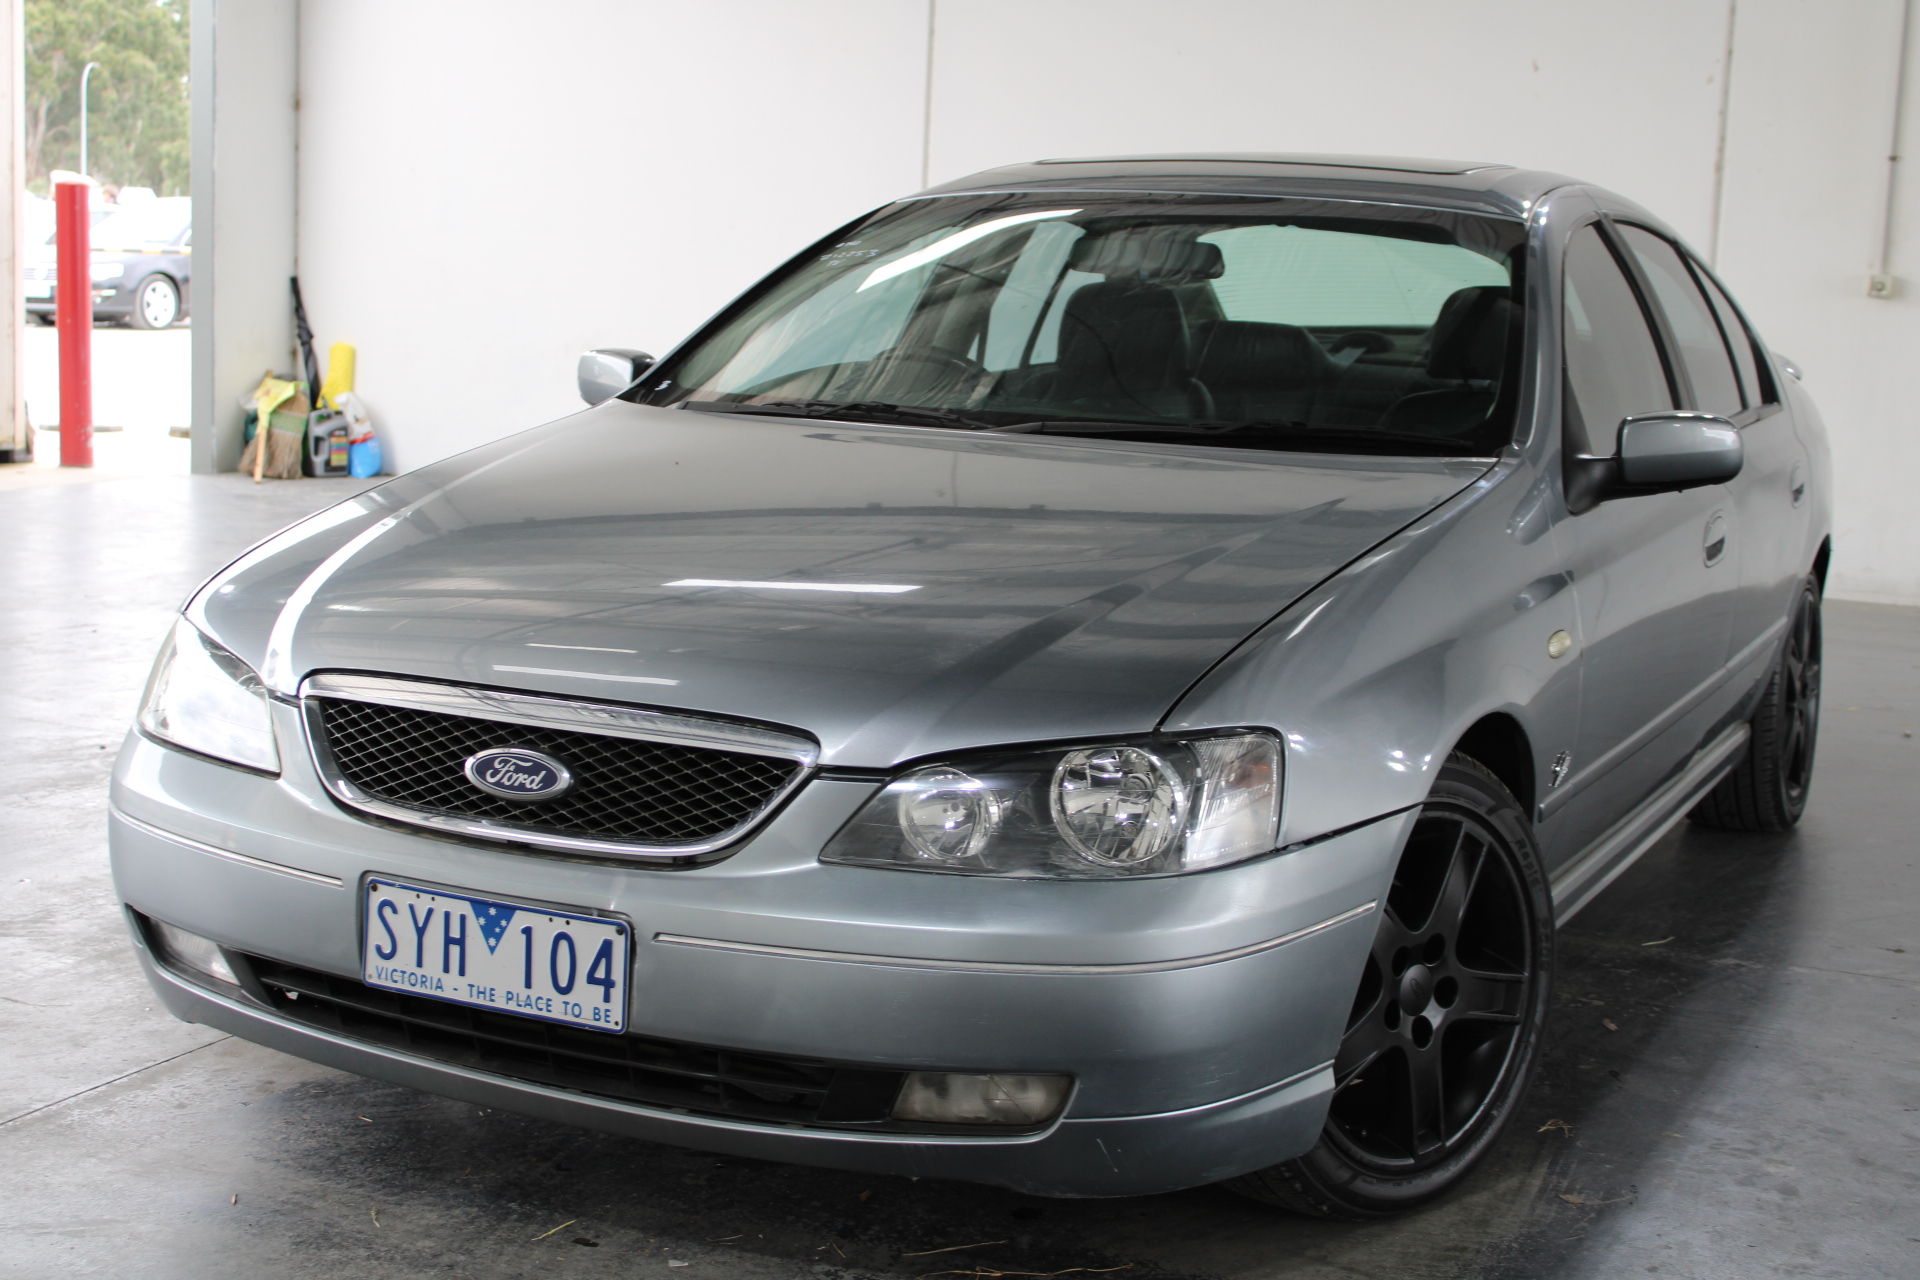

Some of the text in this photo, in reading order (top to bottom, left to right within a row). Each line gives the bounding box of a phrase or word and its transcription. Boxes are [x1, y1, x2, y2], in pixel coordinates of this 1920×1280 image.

[485, 756, 544, 790] Ford
[374, 897, 616, 1004] SYH 104
[375, 964, 444, 992] VICTORIA
[467, 983, 496, 1003] THE
[506, 990, 553, 1014] PLACE
[562, 1000, 583, 1018] TO
[593, 1007, 612, 1024] BE
